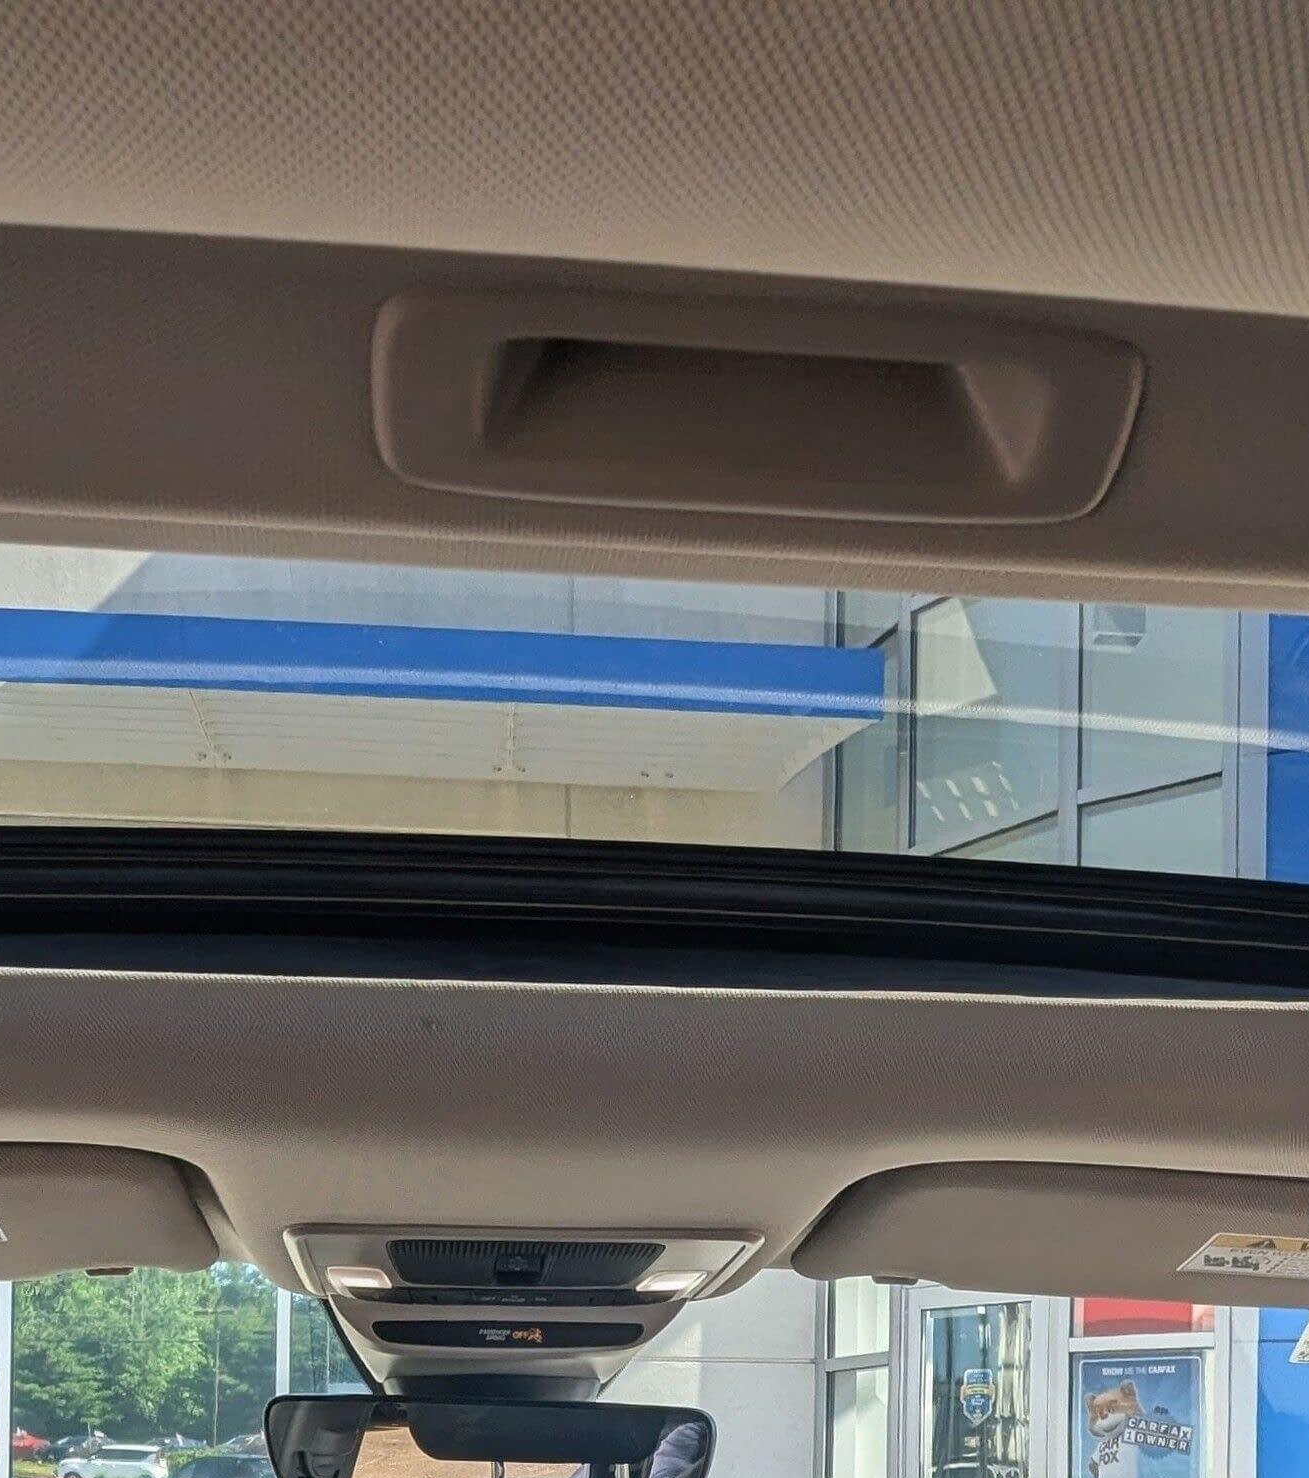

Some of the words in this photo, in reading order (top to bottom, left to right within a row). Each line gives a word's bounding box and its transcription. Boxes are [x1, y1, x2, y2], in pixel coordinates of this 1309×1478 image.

[512, 1330, 530, 1340] OFF
[1128, 1418, 1192, 1439] CARFAX
[1099, 1450, 1120, 1465] FOX
